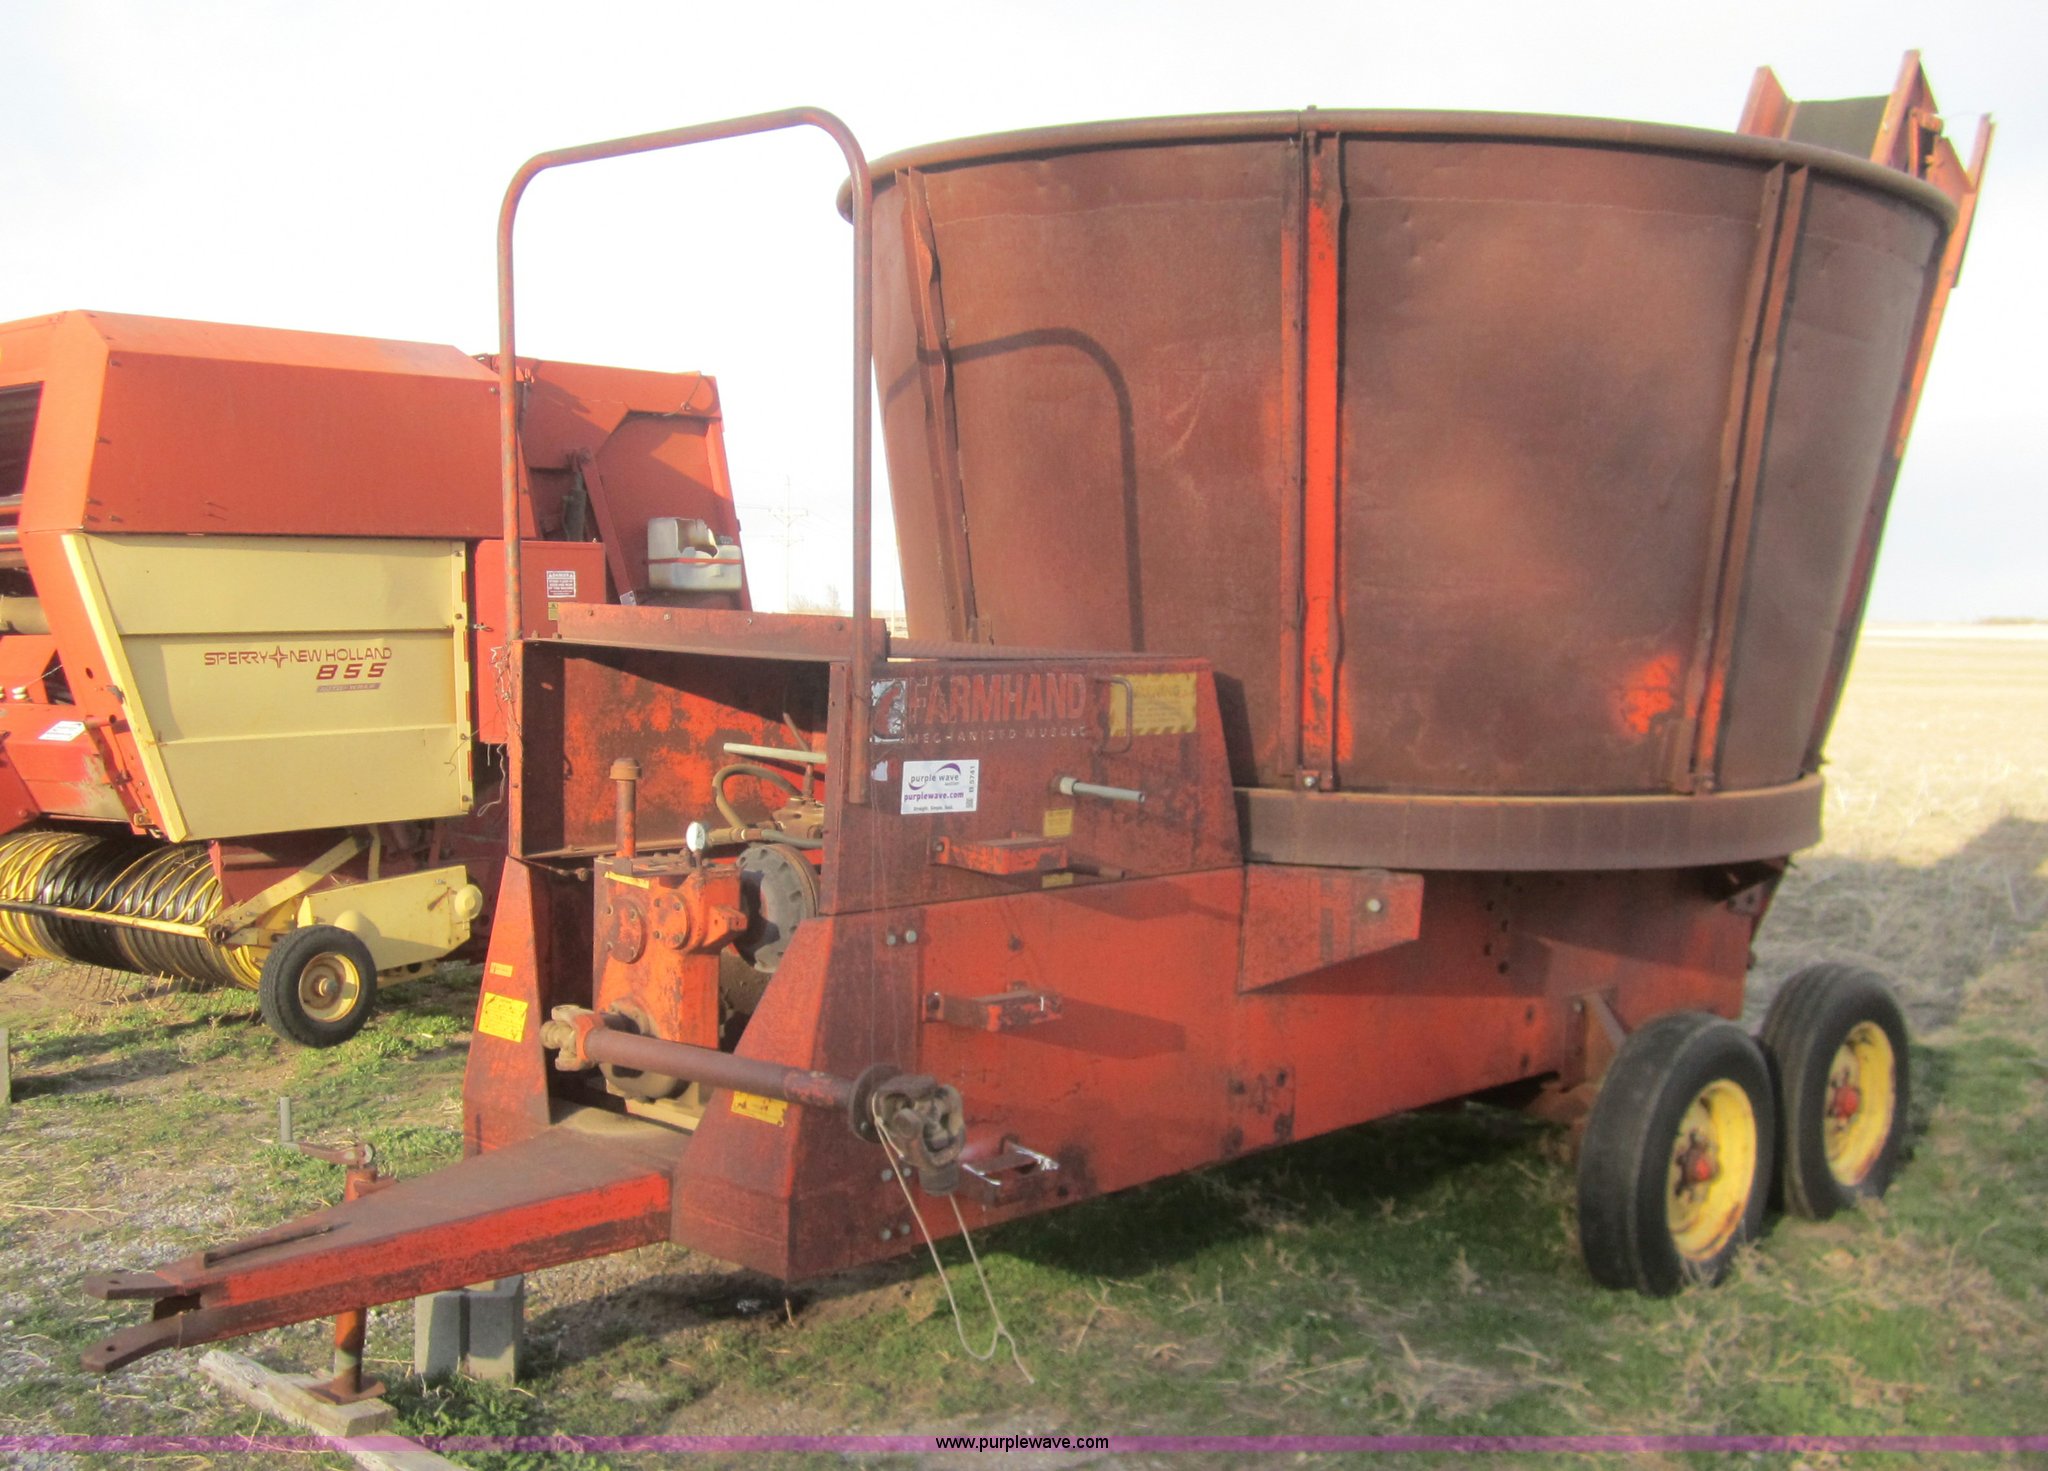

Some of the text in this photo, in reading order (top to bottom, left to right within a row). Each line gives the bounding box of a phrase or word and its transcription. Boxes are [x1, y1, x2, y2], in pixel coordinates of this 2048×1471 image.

[204, 647, 392, 666] SPERRY NEW HOLLAND
[316, 662, 387, 680] 855
[908, 673, 1087, 725] FARMHAND
[910, 773, 936, 783] purple
[904, 792, 964, 802] purplewave.com
